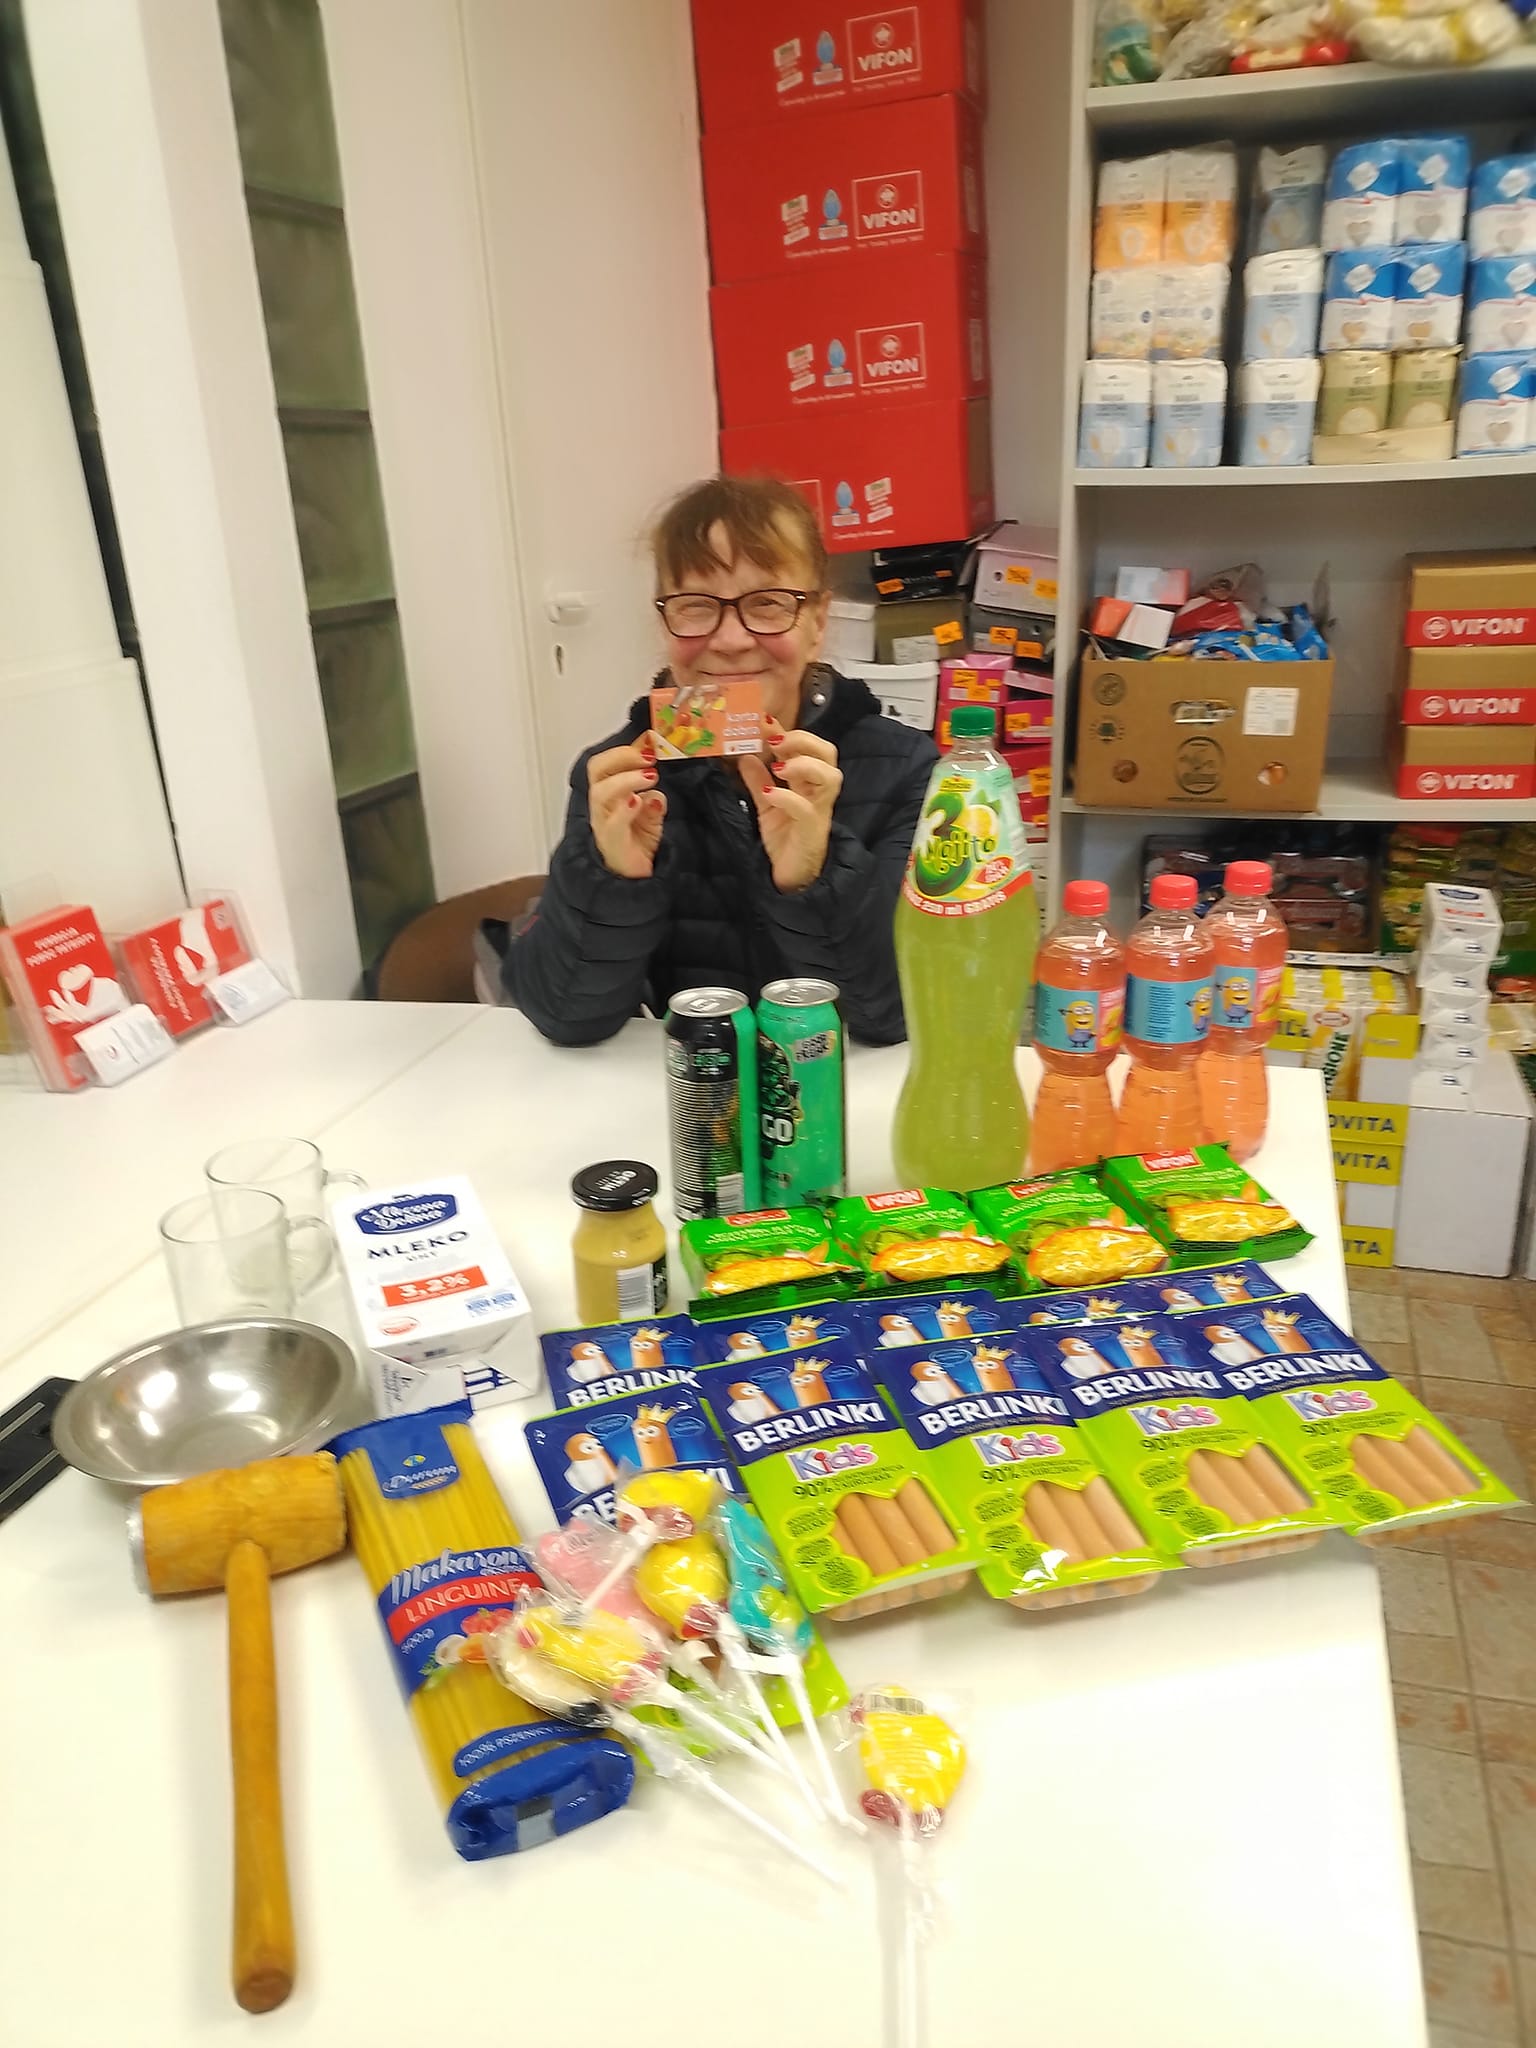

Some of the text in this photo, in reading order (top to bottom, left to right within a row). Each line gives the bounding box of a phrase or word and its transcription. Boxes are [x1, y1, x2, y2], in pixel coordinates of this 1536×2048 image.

[857, 47, 913, 72] VIFON
[863, 208, 916, 229] VIFON
[866, 357, 918, 378] VIFON
[1450, 617, 1525, 637] VIFON
[1448, 696, 1520, 716] VIFON
[1444, 773, 1516, 791] VIFON
[1328, 1115, 1396, 1133] OVITA
[1333, 1152, 1391, 1170] VITA
[367, 1231, 469, 1259] MLEKO
[1224, 1354, 1373, 1391] BERLINKI
[567, 1369, 702, 1408] BERLINK
[1071, 1370, 1221, 1406] BERLINKI
[918, 1395, 1070, 1435] BERLINKI
[1128, 1405, 1221, 1436] Kids
[1284, 1391, 1377, 1421] Kids
[733, 1402, 886, 1452] BERLINKI
[786, 1443, 878, 1482] Kids
[971, 1433, 1065, 1466] Kids
[391, 1548, 518, 1605] Makaron
[405, 1578, 522, 1623] LINGUINE
